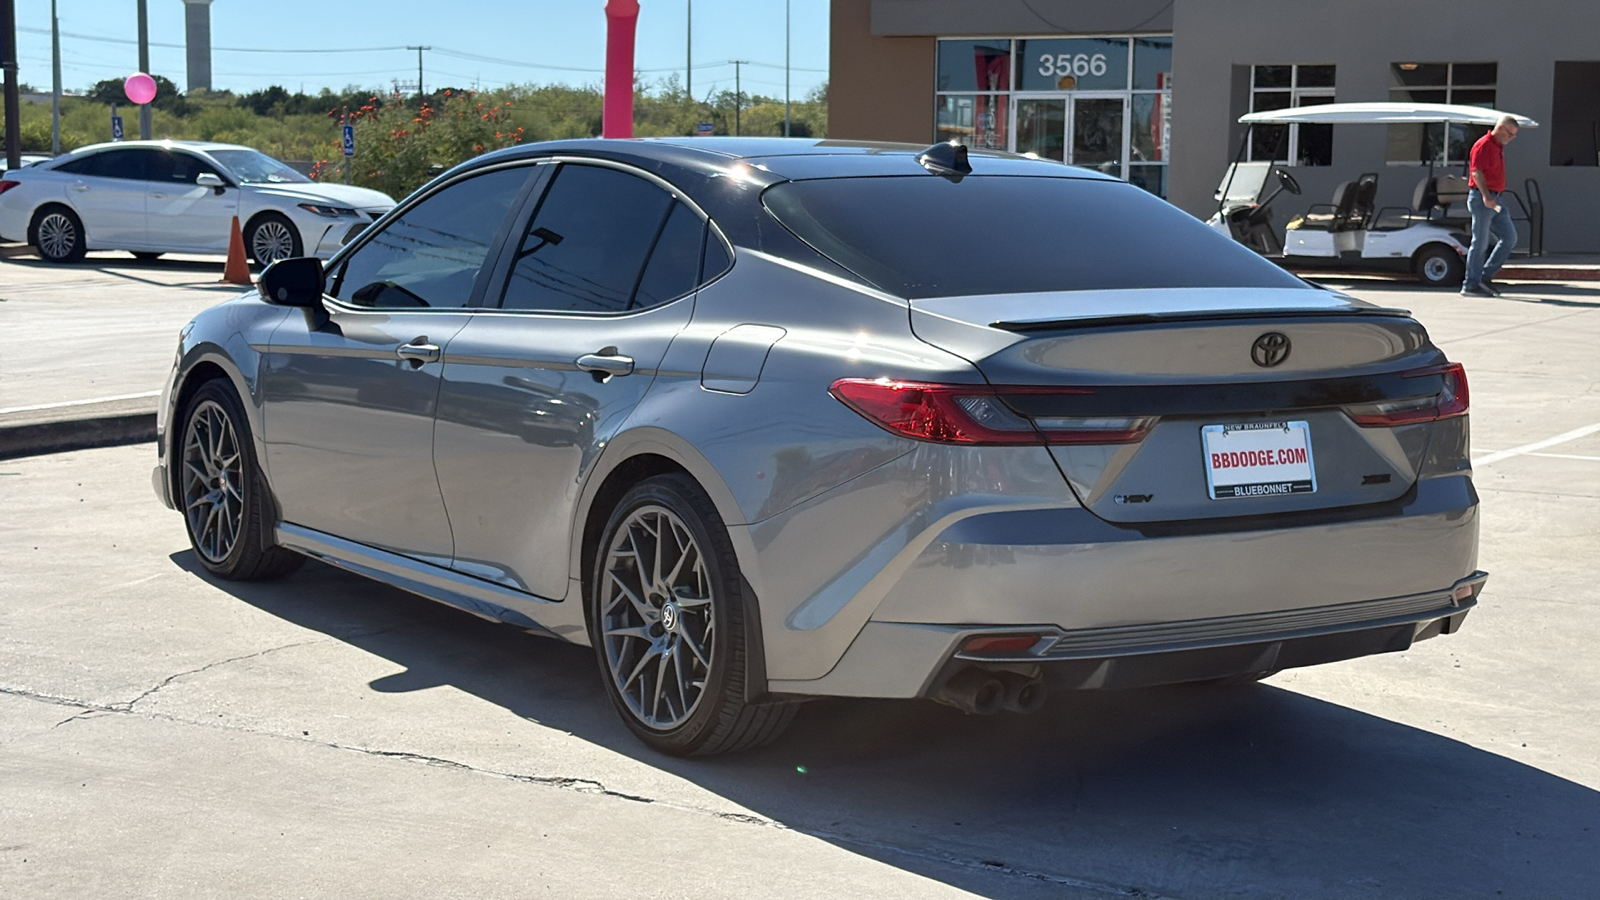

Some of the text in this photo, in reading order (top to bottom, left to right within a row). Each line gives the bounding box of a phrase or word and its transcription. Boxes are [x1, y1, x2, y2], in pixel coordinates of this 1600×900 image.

[1038, 54, 1107, 77] 3566
[1211, 448, 1307, 469] BBDODGE.COM
[1234, 483, 1293, 496] BLUEBONNET
